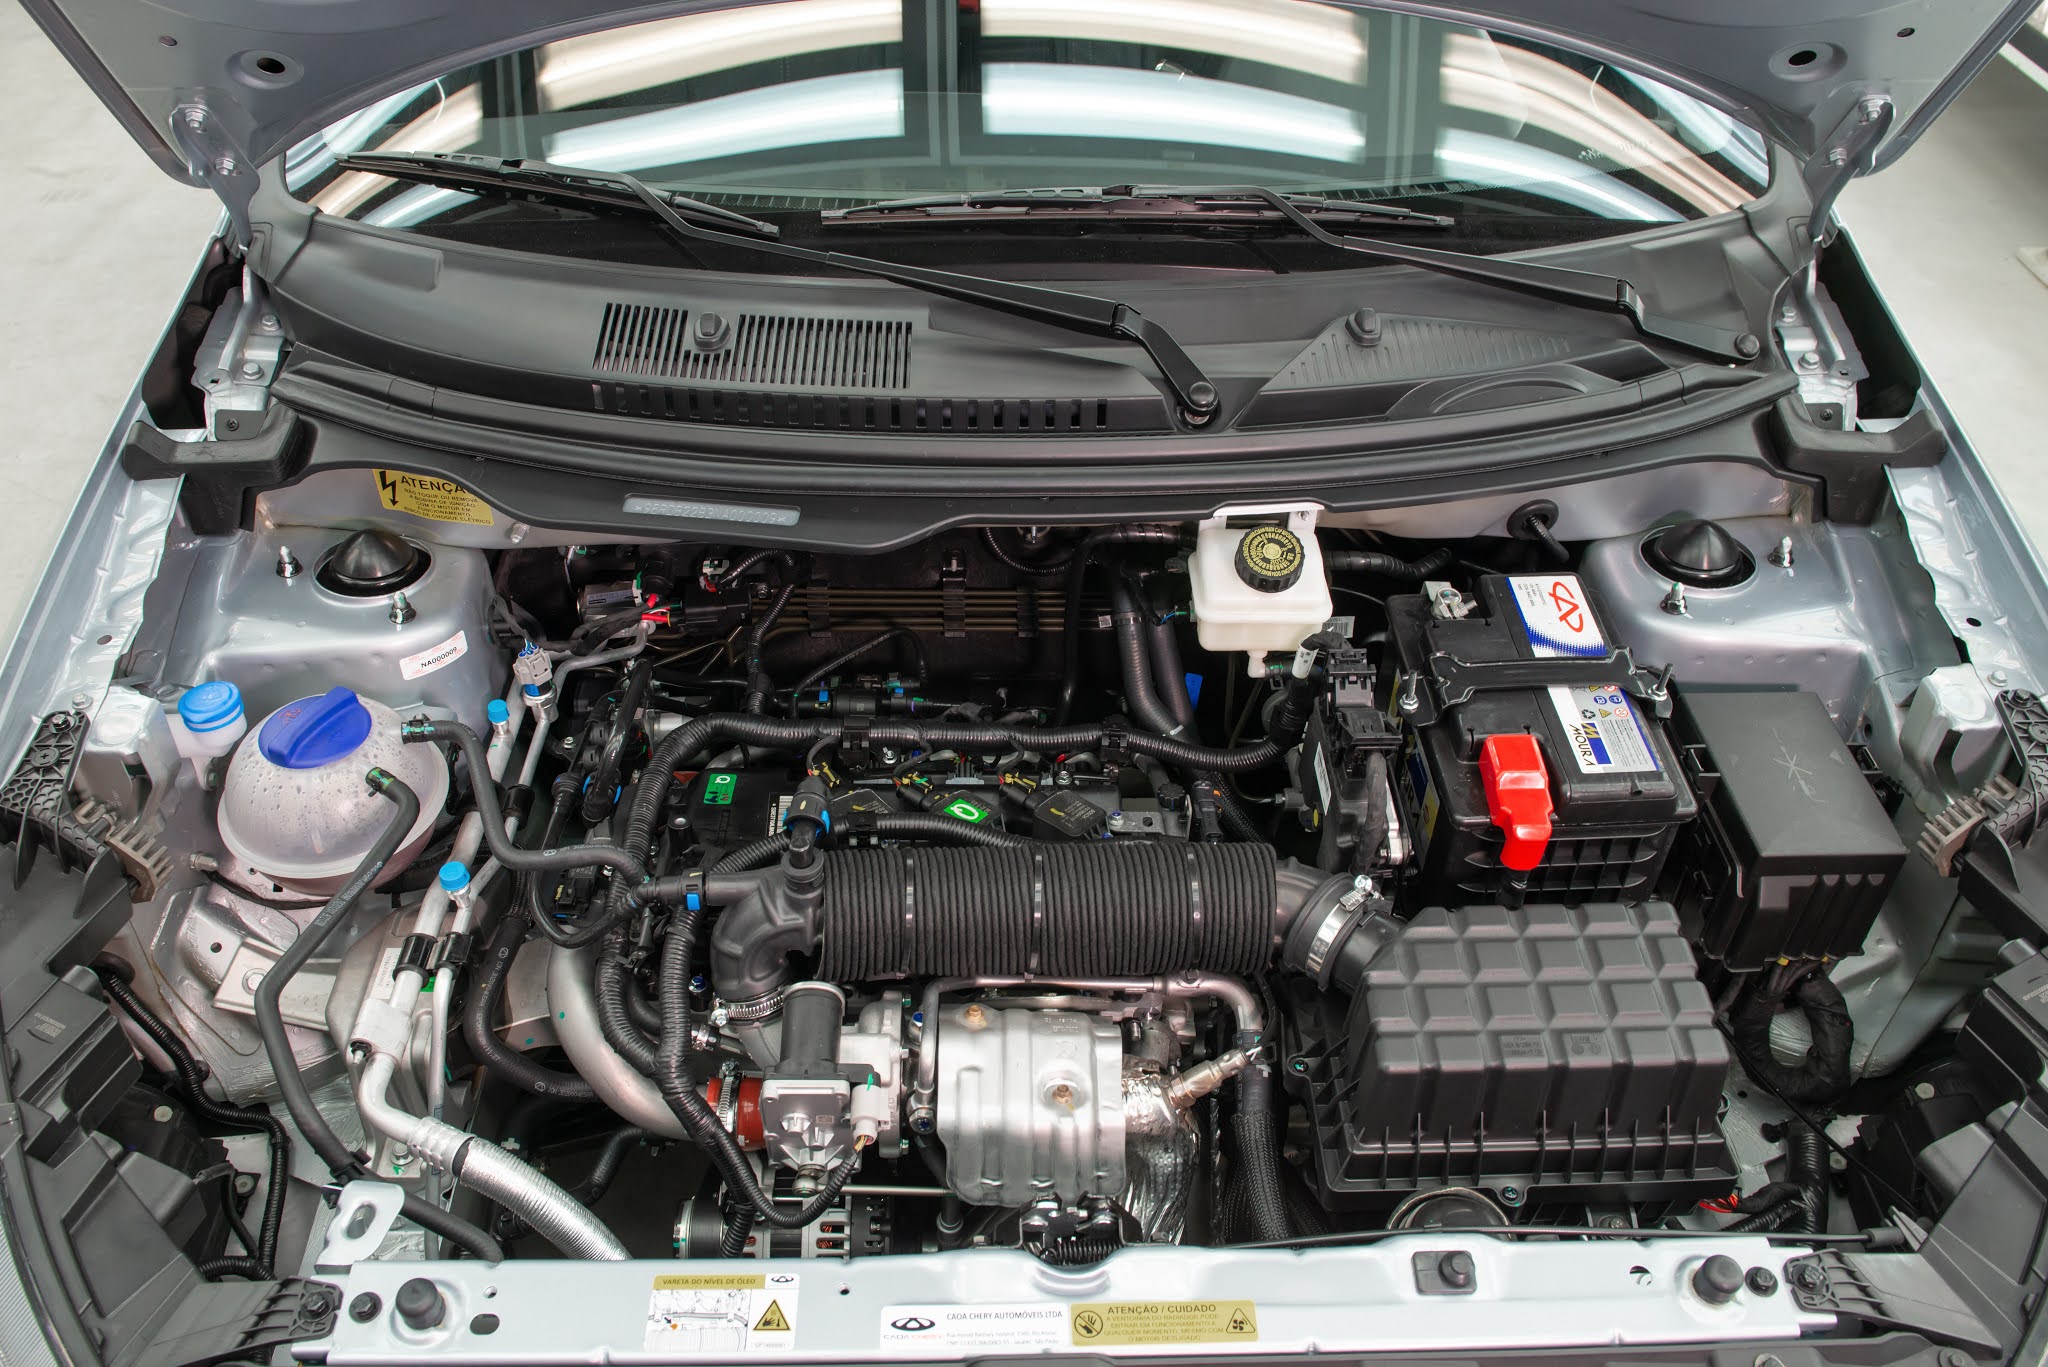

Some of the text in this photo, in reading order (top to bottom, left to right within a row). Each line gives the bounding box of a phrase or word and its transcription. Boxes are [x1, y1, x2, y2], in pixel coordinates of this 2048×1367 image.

[401, 476, 466, 494] ATENÇA
[421, 646, 457, 668] NA000009
[1570, 724, 1596, 766] MOURA
[994, 1310, 1043, 1319] AUTOMÓVEIS
[1107, 1305, 1158, 1315] ATENÇÃO
[1168, 1304, 1216, 1312] CUIDADO
